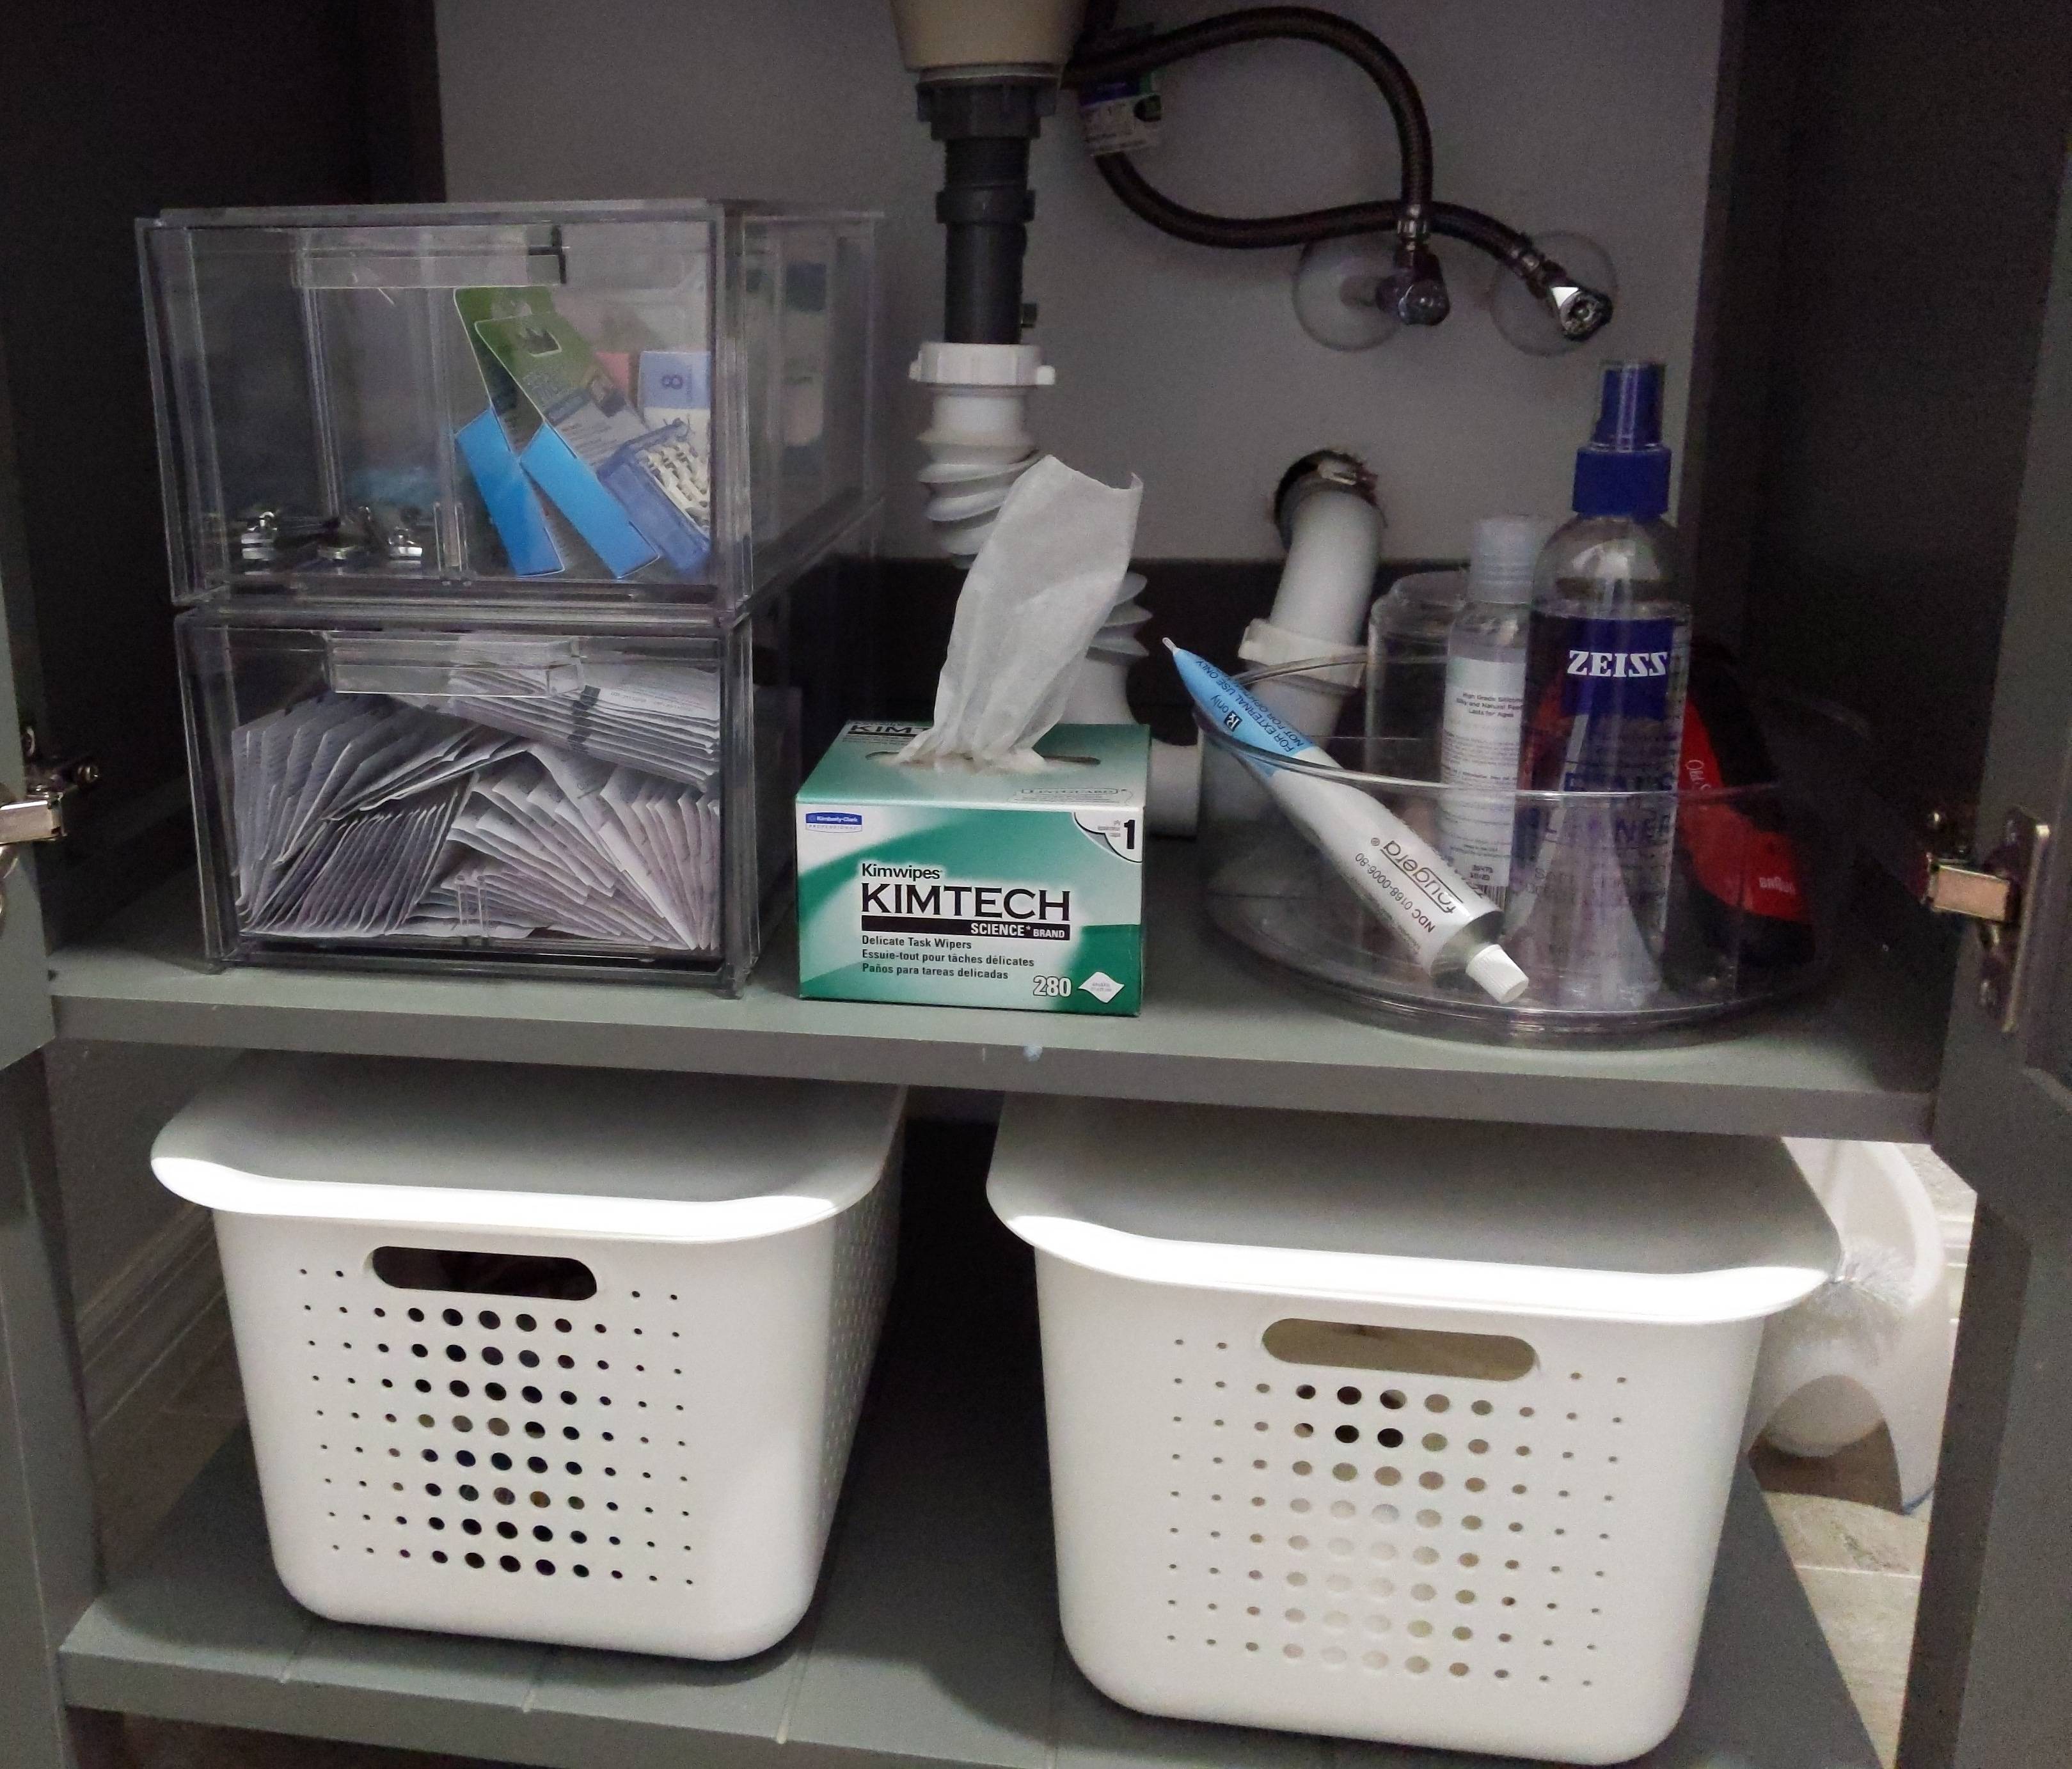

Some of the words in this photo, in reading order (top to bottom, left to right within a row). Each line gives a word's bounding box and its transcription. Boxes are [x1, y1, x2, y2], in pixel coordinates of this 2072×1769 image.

[1196, 659, 1219, 679] ONLY
[1567, 650, 1668, 678] ZEISS
[1216, 679, 1236, 696] USE
[1210, 695, 1230, 713] only
[1235, 695, 1276, 735] EXTERNAL
[1267, 712, 1285, 730] FOR
[1274, 734, 1293, 753] FOR
[1284, 730, 1305, 747] NOT
[1123, 819, 1135, 850] 1
[862, 862, 941, 882] Kimwipes
[1354, 853, 1413, 910] 0168-0006-80
[861, 882, 1070, 921] KIMTECH
[1411, 908, 1435, 933] NDC
[862, 935, 905, 947] Delicate
[908, 937, 931, 948] Task
[934, 938, 972, 951] Wipers
[1032, 929, 1065, 939] BRAND
[862, 949, 919, 961] Essuie-tout
[922, 954, 945, 964] pour
[948, 952, 983, 964] tâches
[986, 954, 1035, 968] délicates
[862, 963, 894, 974] Paños
[896, 966, 919, 976] para
[922, 967, 954, 977] tareas
[958, 967, 1009, 980] delicadas
[1032, 975, 1072, 998] 280
